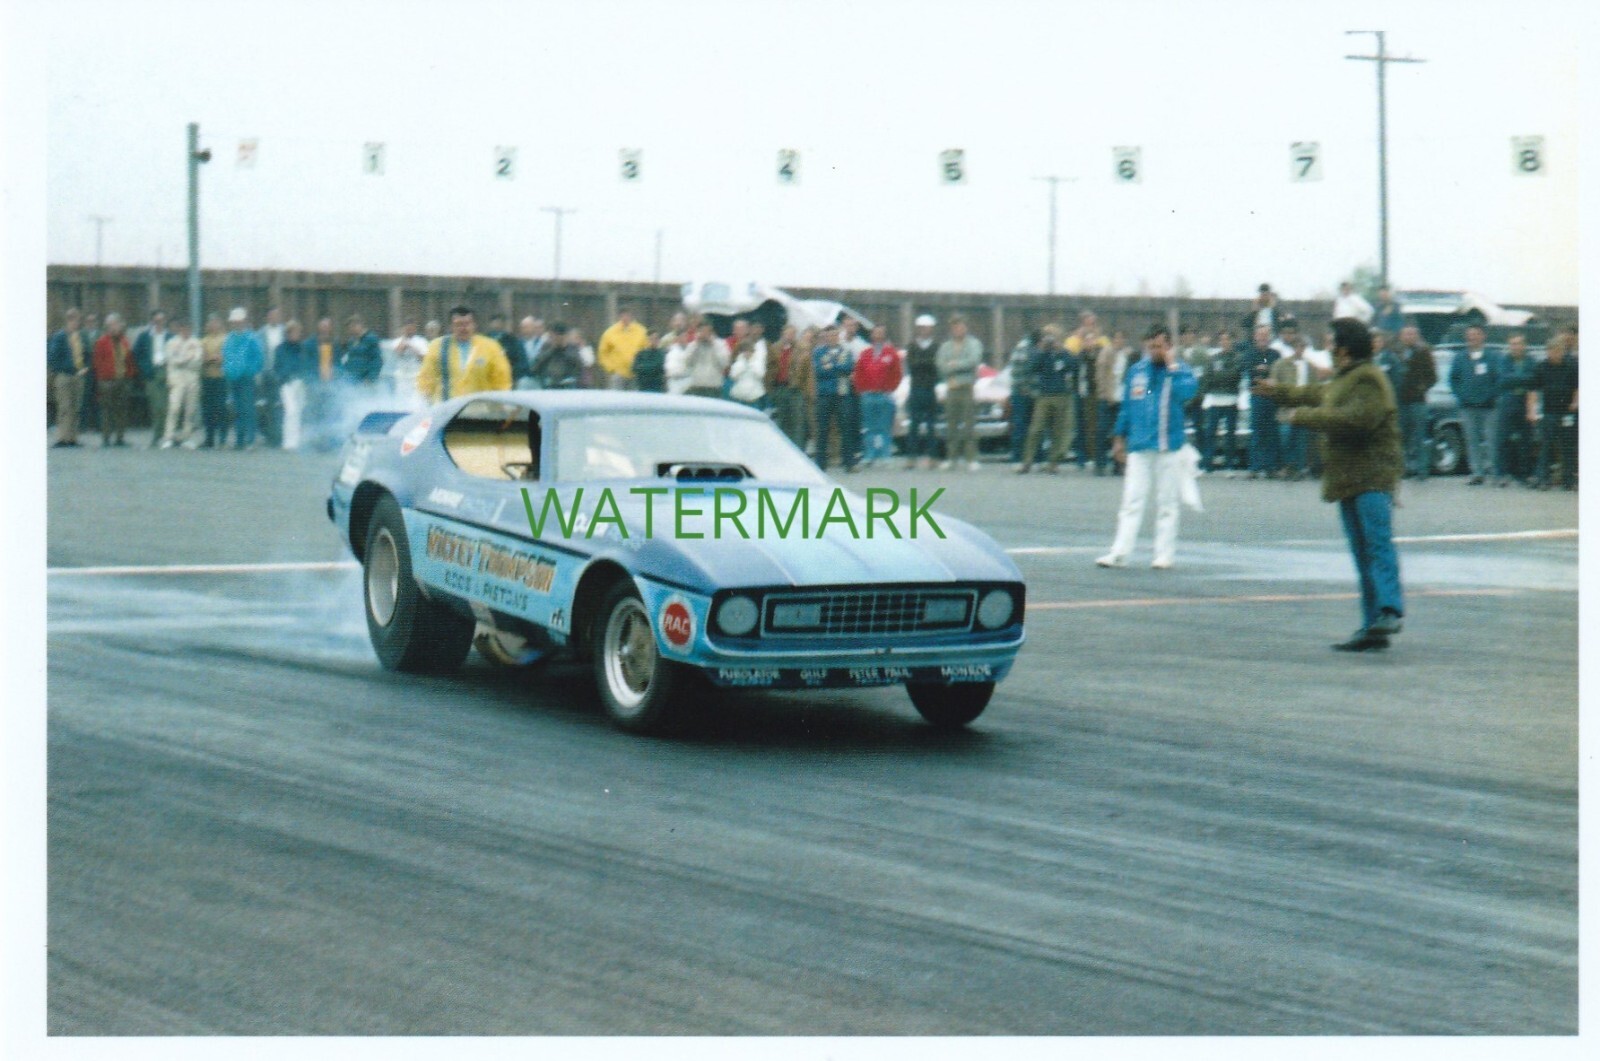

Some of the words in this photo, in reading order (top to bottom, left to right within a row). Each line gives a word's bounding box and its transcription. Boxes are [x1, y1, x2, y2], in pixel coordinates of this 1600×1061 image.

[497, 157, 511, 175] 2
[622, 160, 638, 179] 3
[779, 161, 793, 180] 4
[1118, 159, 1136, 180] 6
[1296, 156, 1315, 177] 7
[1519, 149, 1541, 172] 8
[944, 161, 962, 181] 5
[664, 613, 689, 635] RAC
